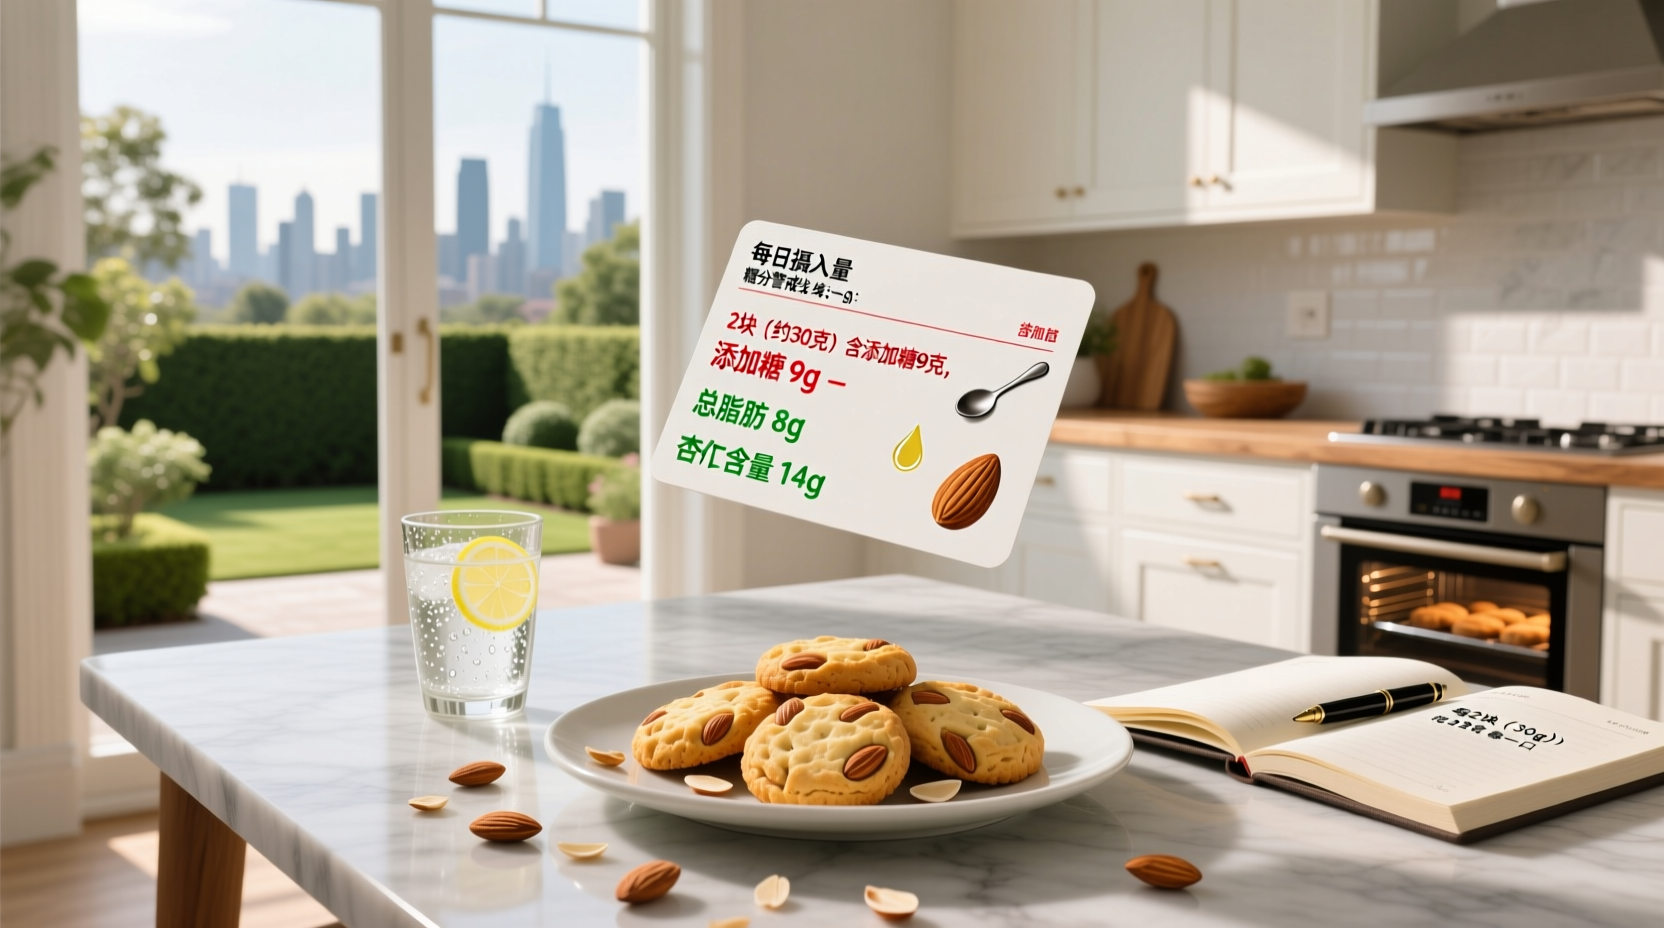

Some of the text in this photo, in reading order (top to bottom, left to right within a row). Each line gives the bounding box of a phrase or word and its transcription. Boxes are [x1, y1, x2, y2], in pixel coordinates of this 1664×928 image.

[751, 241, 853, 282] 每日摄入量
[710, 341, 787, 381] 添加糖
[789, 360, 821, 394] 9g
[692, 388, 806, 444] 总脂肪 8g
[781, 461, 826, 500] 14g
